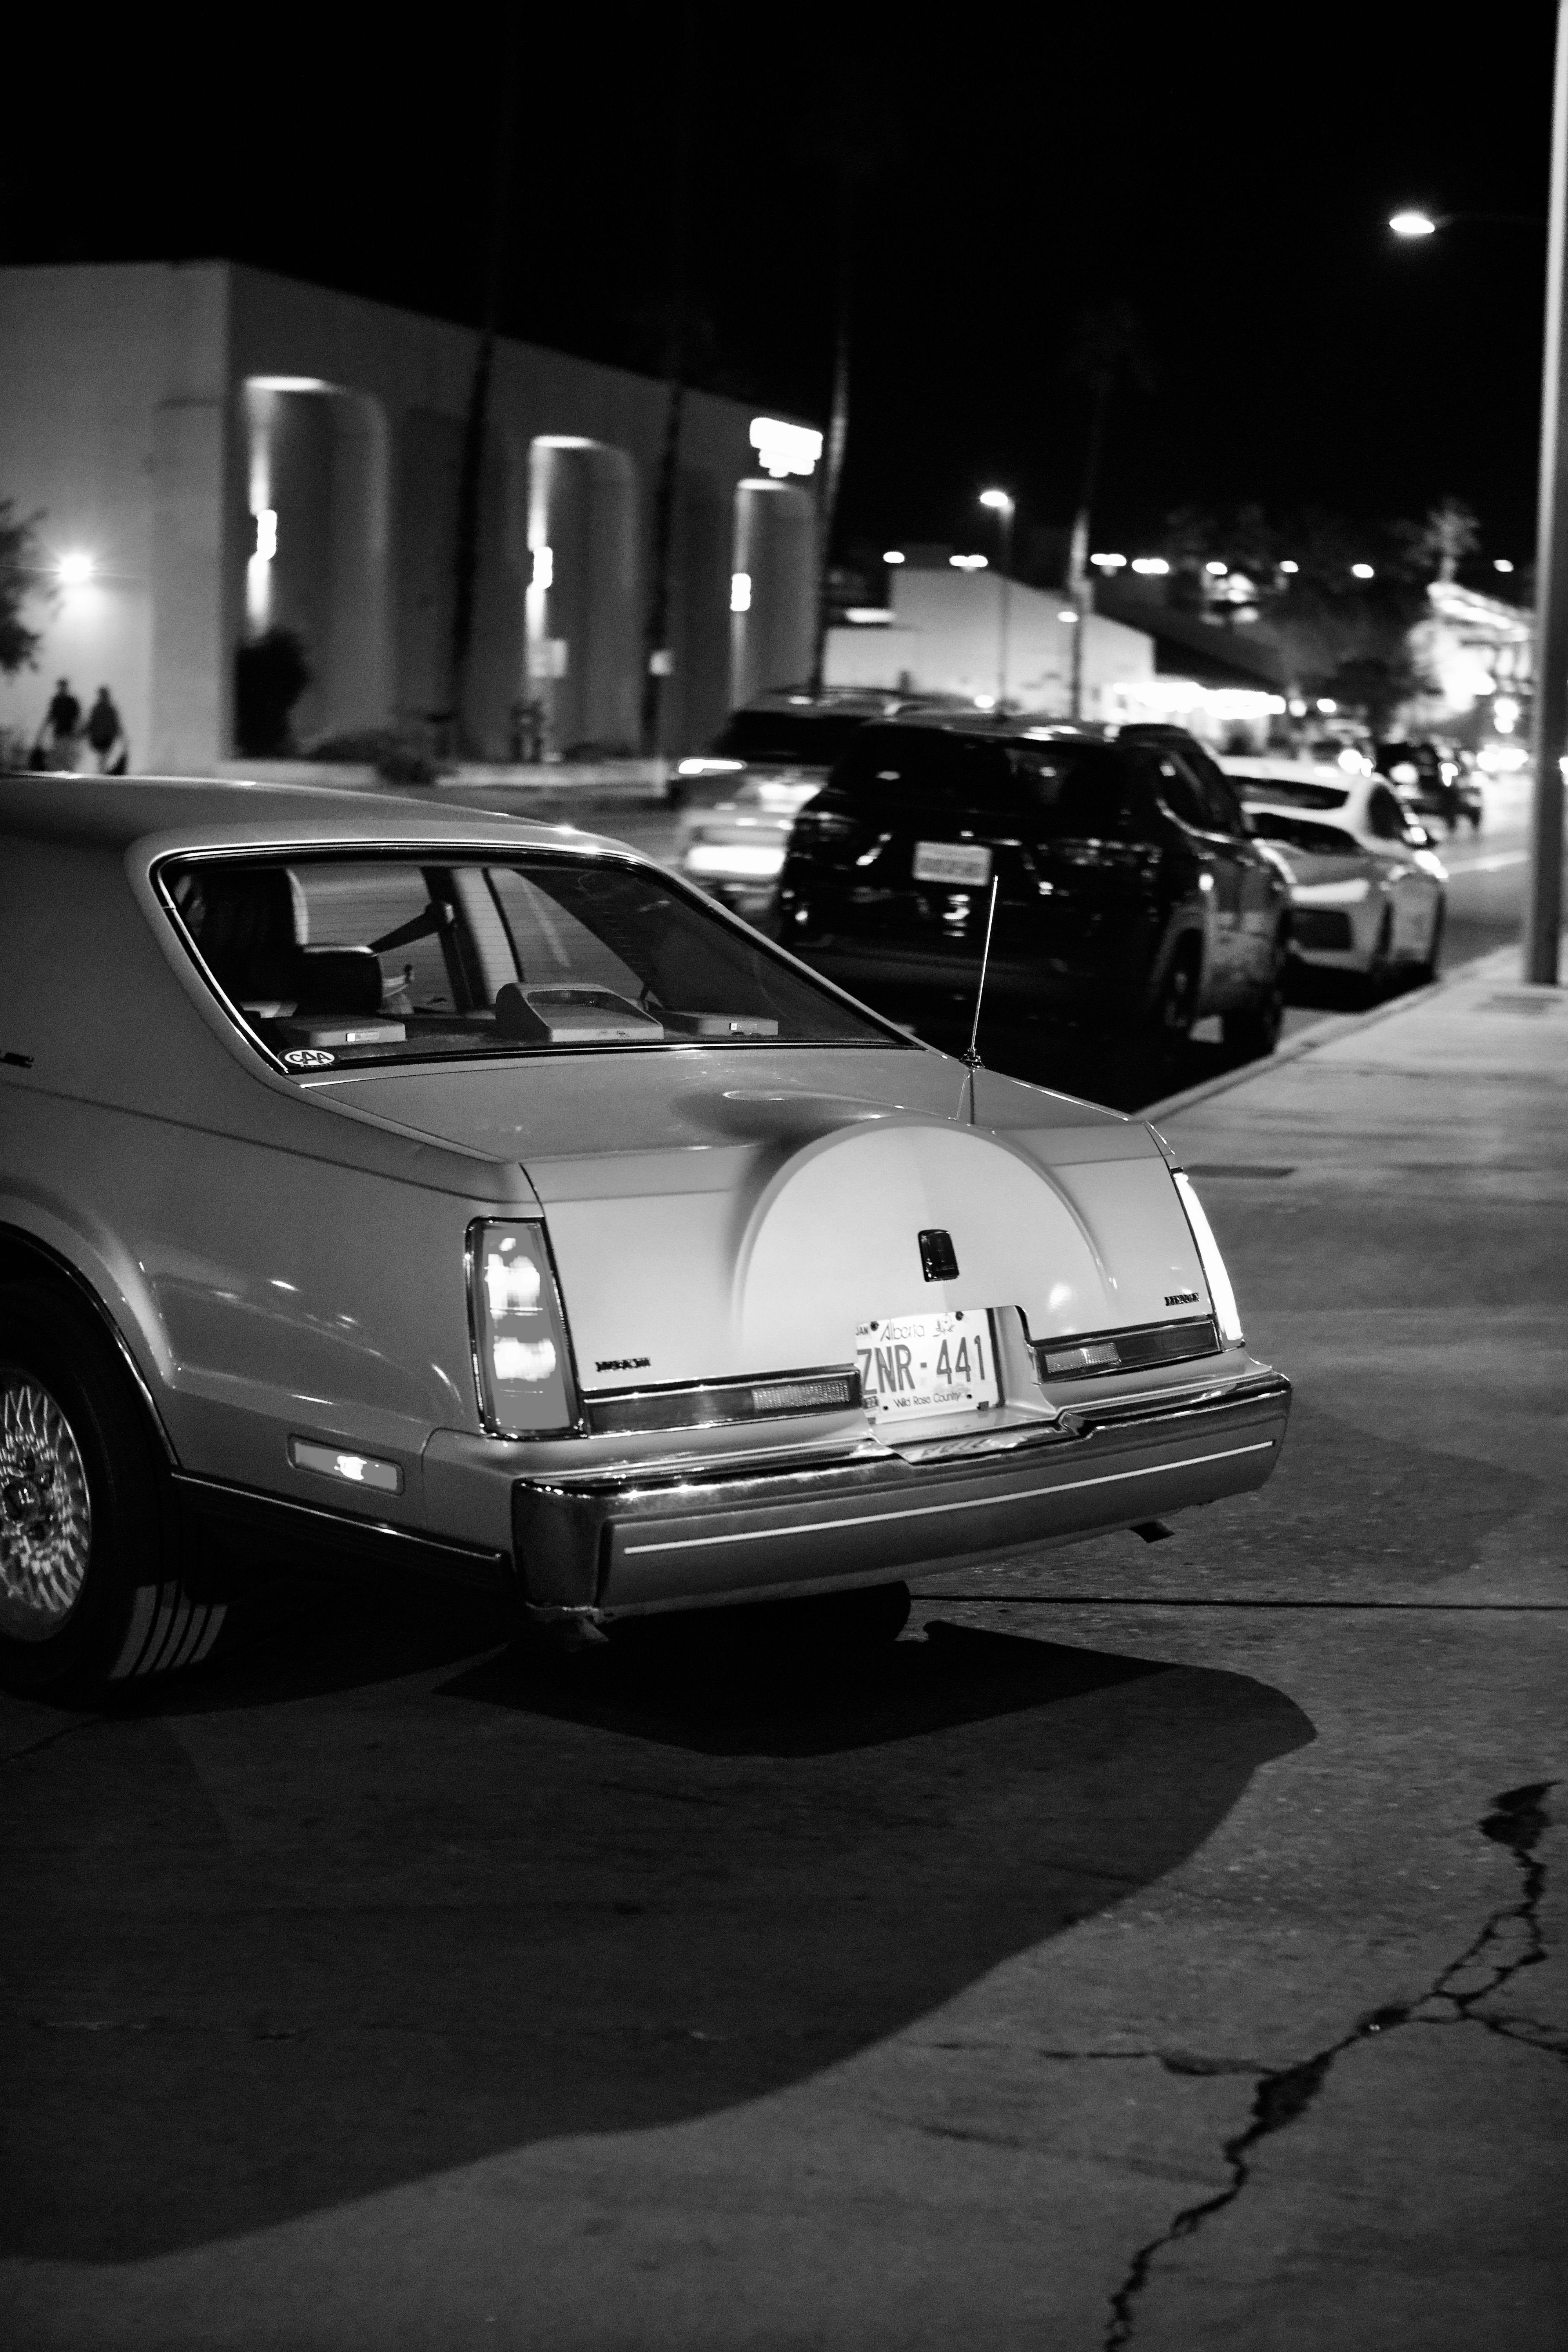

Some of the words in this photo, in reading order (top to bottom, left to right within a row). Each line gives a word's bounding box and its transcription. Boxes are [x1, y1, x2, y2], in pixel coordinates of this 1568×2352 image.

[289, 1051, 332, 1064] CAA
[880, 1319, 925, 1341] Alberta
[893, 1397, 911, 1408] Wild
[913, 1396, 931, 1406] Rose
[933, 1392, 960, 1403] Country
